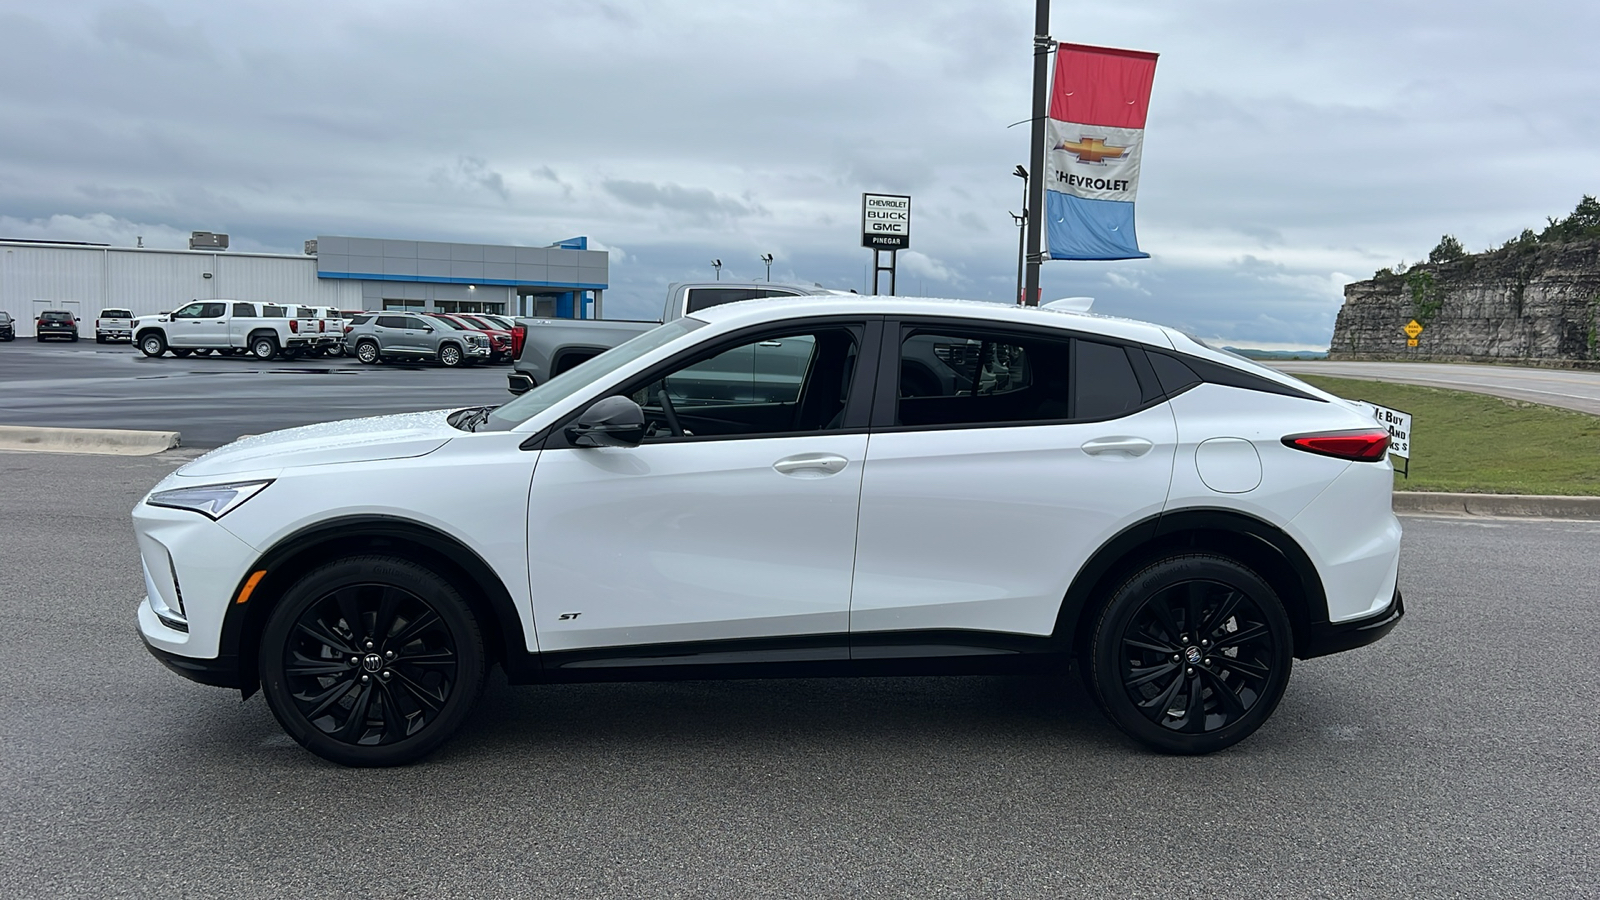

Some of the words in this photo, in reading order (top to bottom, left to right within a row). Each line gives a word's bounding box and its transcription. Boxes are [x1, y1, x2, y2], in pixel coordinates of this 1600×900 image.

[868, 199, 907, 208] CHEVROLET
[867, 211, 907, 220] BUICK
[872, 222, 902, 232] GMC
[872, 237, 901, 245] PINEGAR
[558, 612, 582, 621] ST
